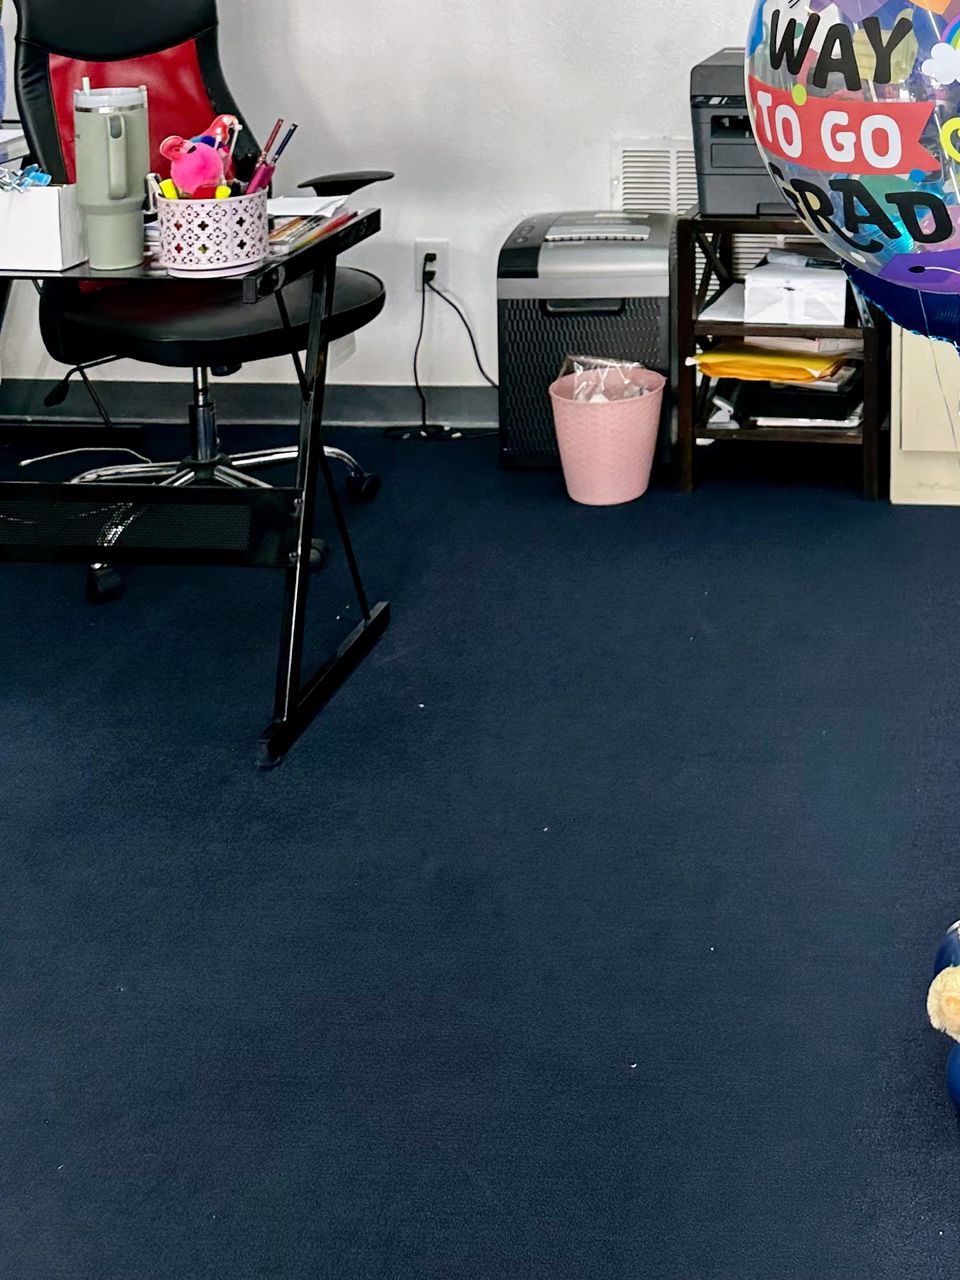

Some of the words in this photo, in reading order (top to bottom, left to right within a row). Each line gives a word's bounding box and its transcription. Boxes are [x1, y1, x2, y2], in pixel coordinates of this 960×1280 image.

[770, 9, 913, 91] WAY
[756, 91, 803, 158] TO
[821, 111, 901, 169] GO
